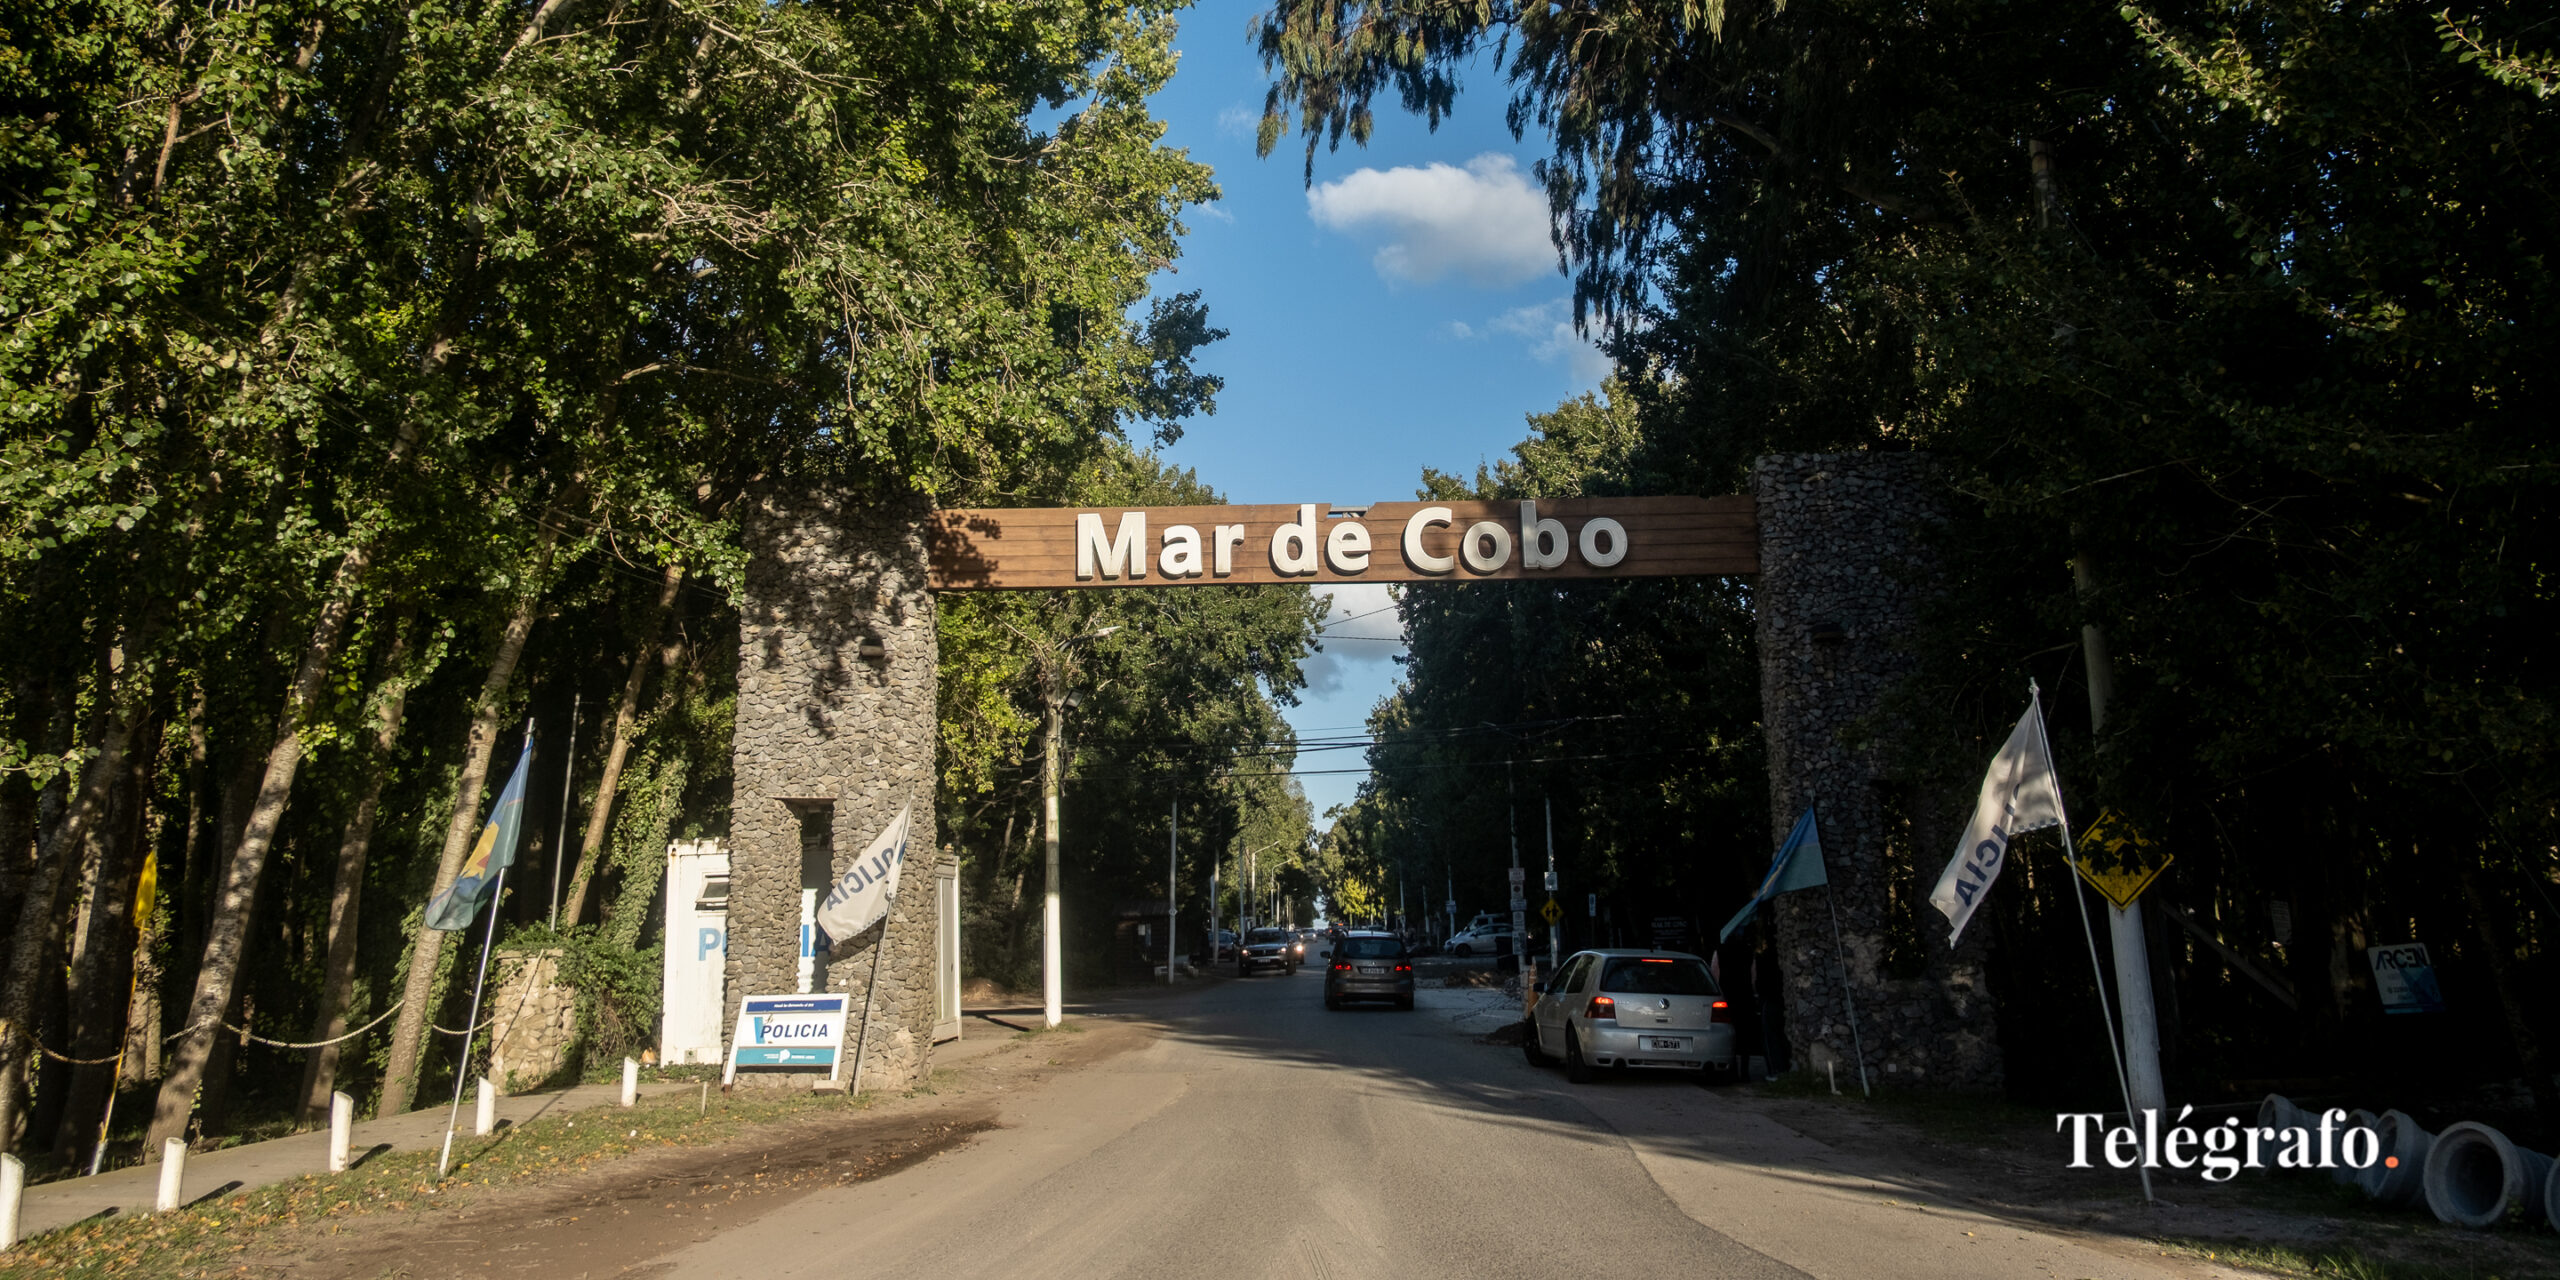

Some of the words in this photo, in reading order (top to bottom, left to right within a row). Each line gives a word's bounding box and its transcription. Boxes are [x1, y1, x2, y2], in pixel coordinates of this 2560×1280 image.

[1075, 511, 1246, 578] Mar
[1269, 503, 1372, 575] de
[1402, 499, 1629, 576] Cobo
[760, 1023, 828, 1039] POLICIA
